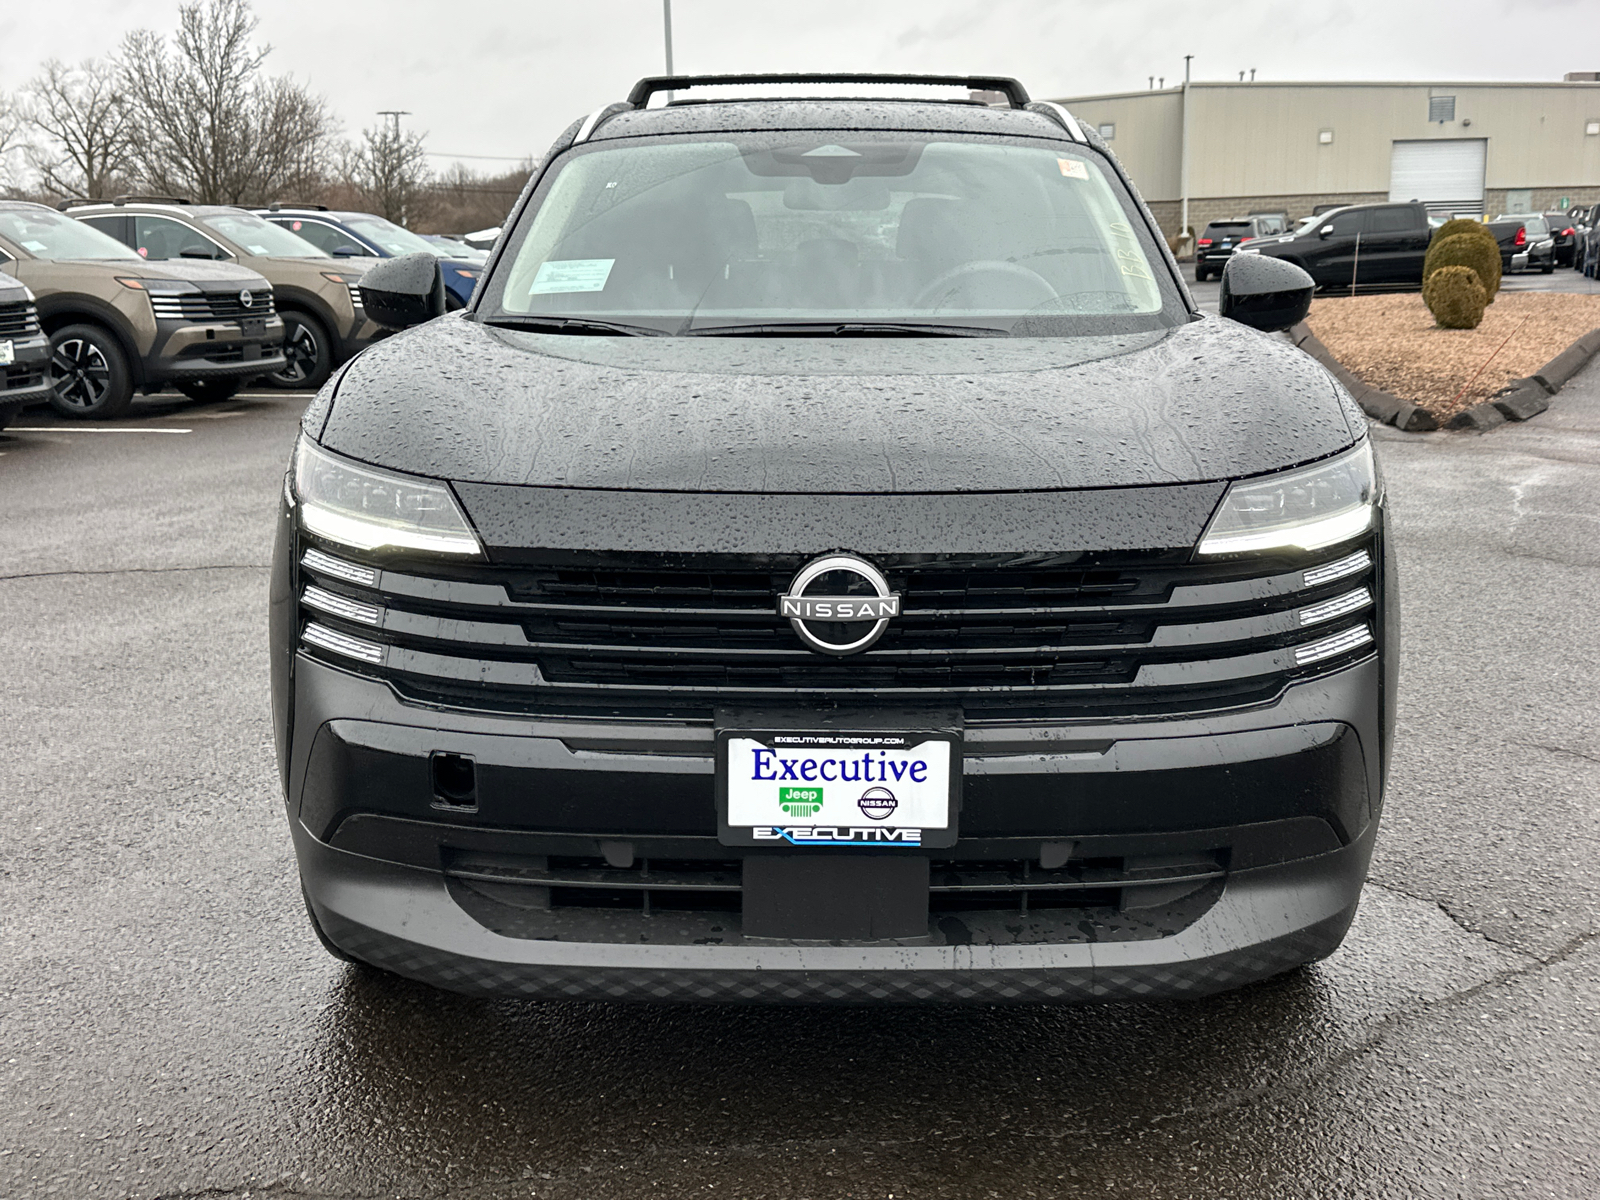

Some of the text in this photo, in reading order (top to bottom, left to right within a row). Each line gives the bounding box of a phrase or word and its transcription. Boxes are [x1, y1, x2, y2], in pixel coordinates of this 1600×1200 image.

[783, 600, 897, 618] NISSAN
[774, 736, 904, 745] EXECUTIVEAUTOGROUP.COM
[751, 748, 928, 783] Executive
[785, 788, 817, 801] Jeep
[860, 799, 896, 807] NISSAN
[752, 827, 922, 842] EXECUTIVE
